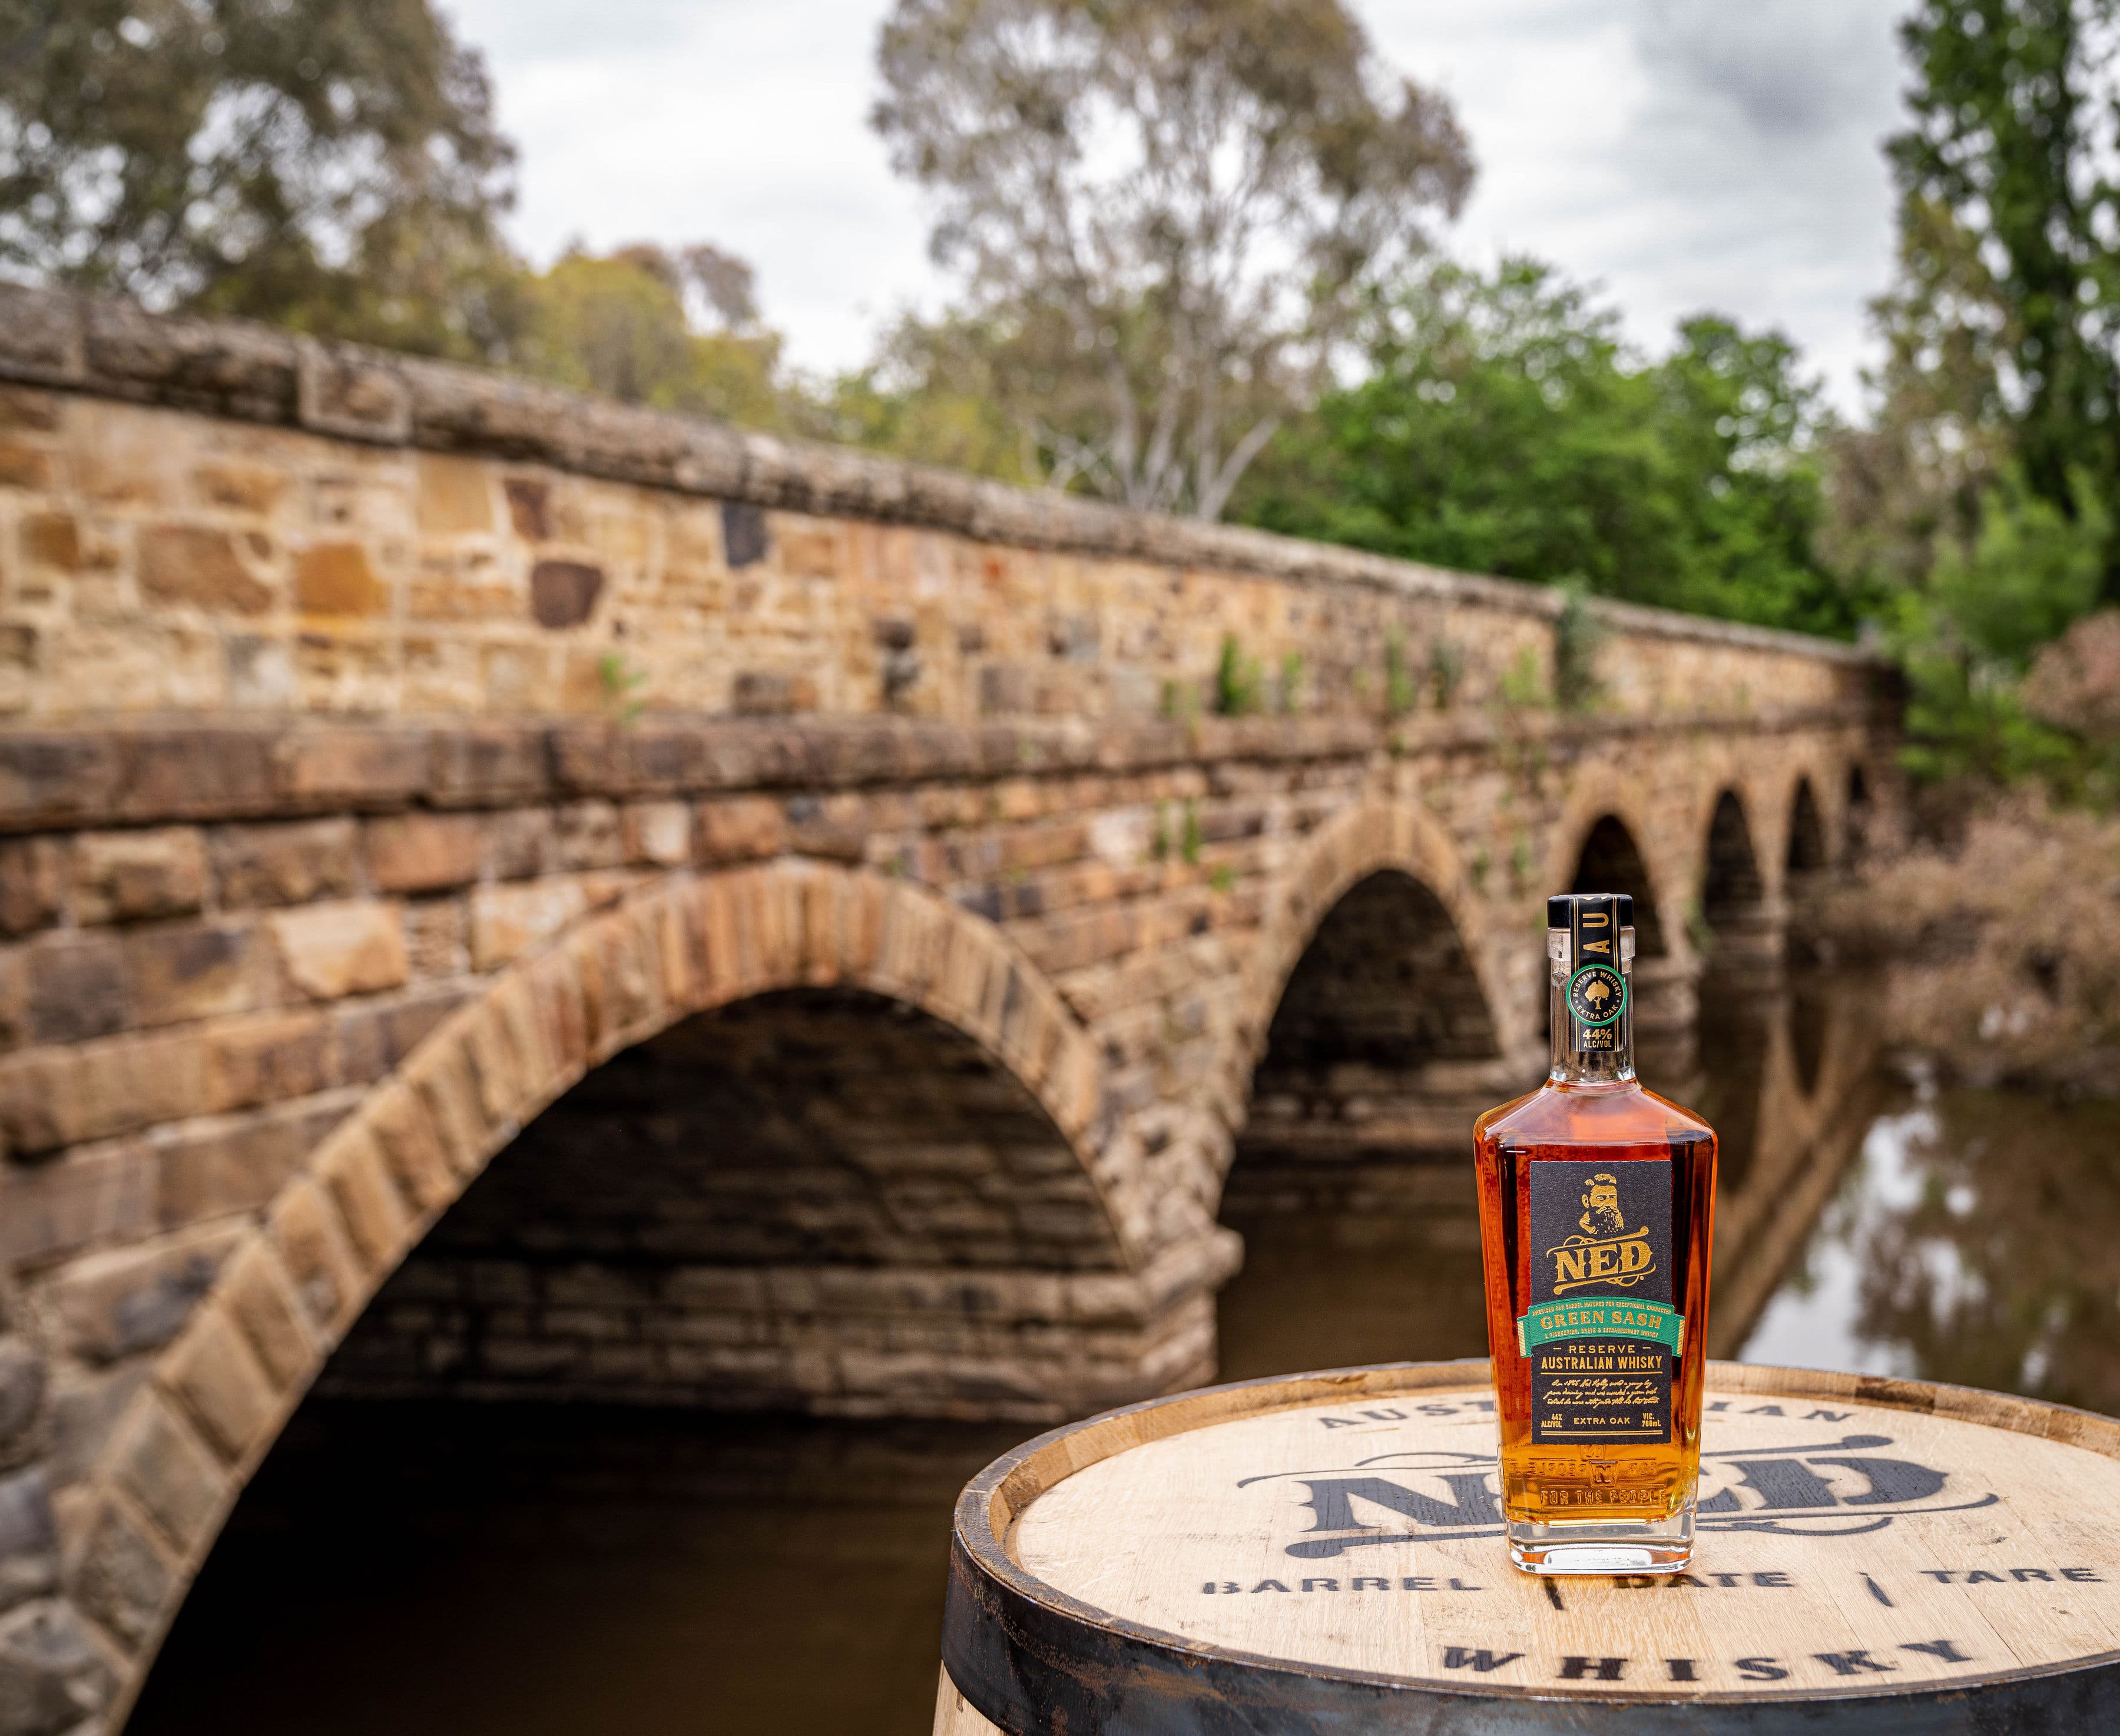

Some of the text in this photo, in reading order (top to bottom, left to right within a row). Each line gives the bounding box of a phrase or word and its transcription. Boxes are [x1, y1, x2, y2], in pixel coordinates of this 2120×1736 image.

[1582, 896, 1609, 953] AU
[1573, 971, 1622, 998] RESERVE WHISKY
[1576, 1004, 1618, 1020] EXTRA OAK
[1582, 1029, 1612, 1040] 44%
[1583, 1040, 1612, 1048] ALC/VOL
[1553, 1240, 1653, 1283] NED
[1532, 1306, 1555, 1317] AMERICAN
[1616, 1301, 1645, 1310] EXCEPTIONAL
[1647, 1304, 1672, 1315] CHARACTER
[1540, 1310, 1662, 1330] GREEN SASH
[1603, 1327, 1639, 1335] EXTRAORDINARY
[1641, 1330, 1659, 1338] WHISKY
[1569, 1344, 1635, 1354] RESERVE
[1541, 1356, 1662, 1370] AUSTRALIAN WHISKY
[1540, 1489, 1667, 1505] FOR THE PEOPLE
[1202, 1567, 2104, 1593] BARREL DATE TARE
[1443, 1639, 1973, 1682] WHISKY
